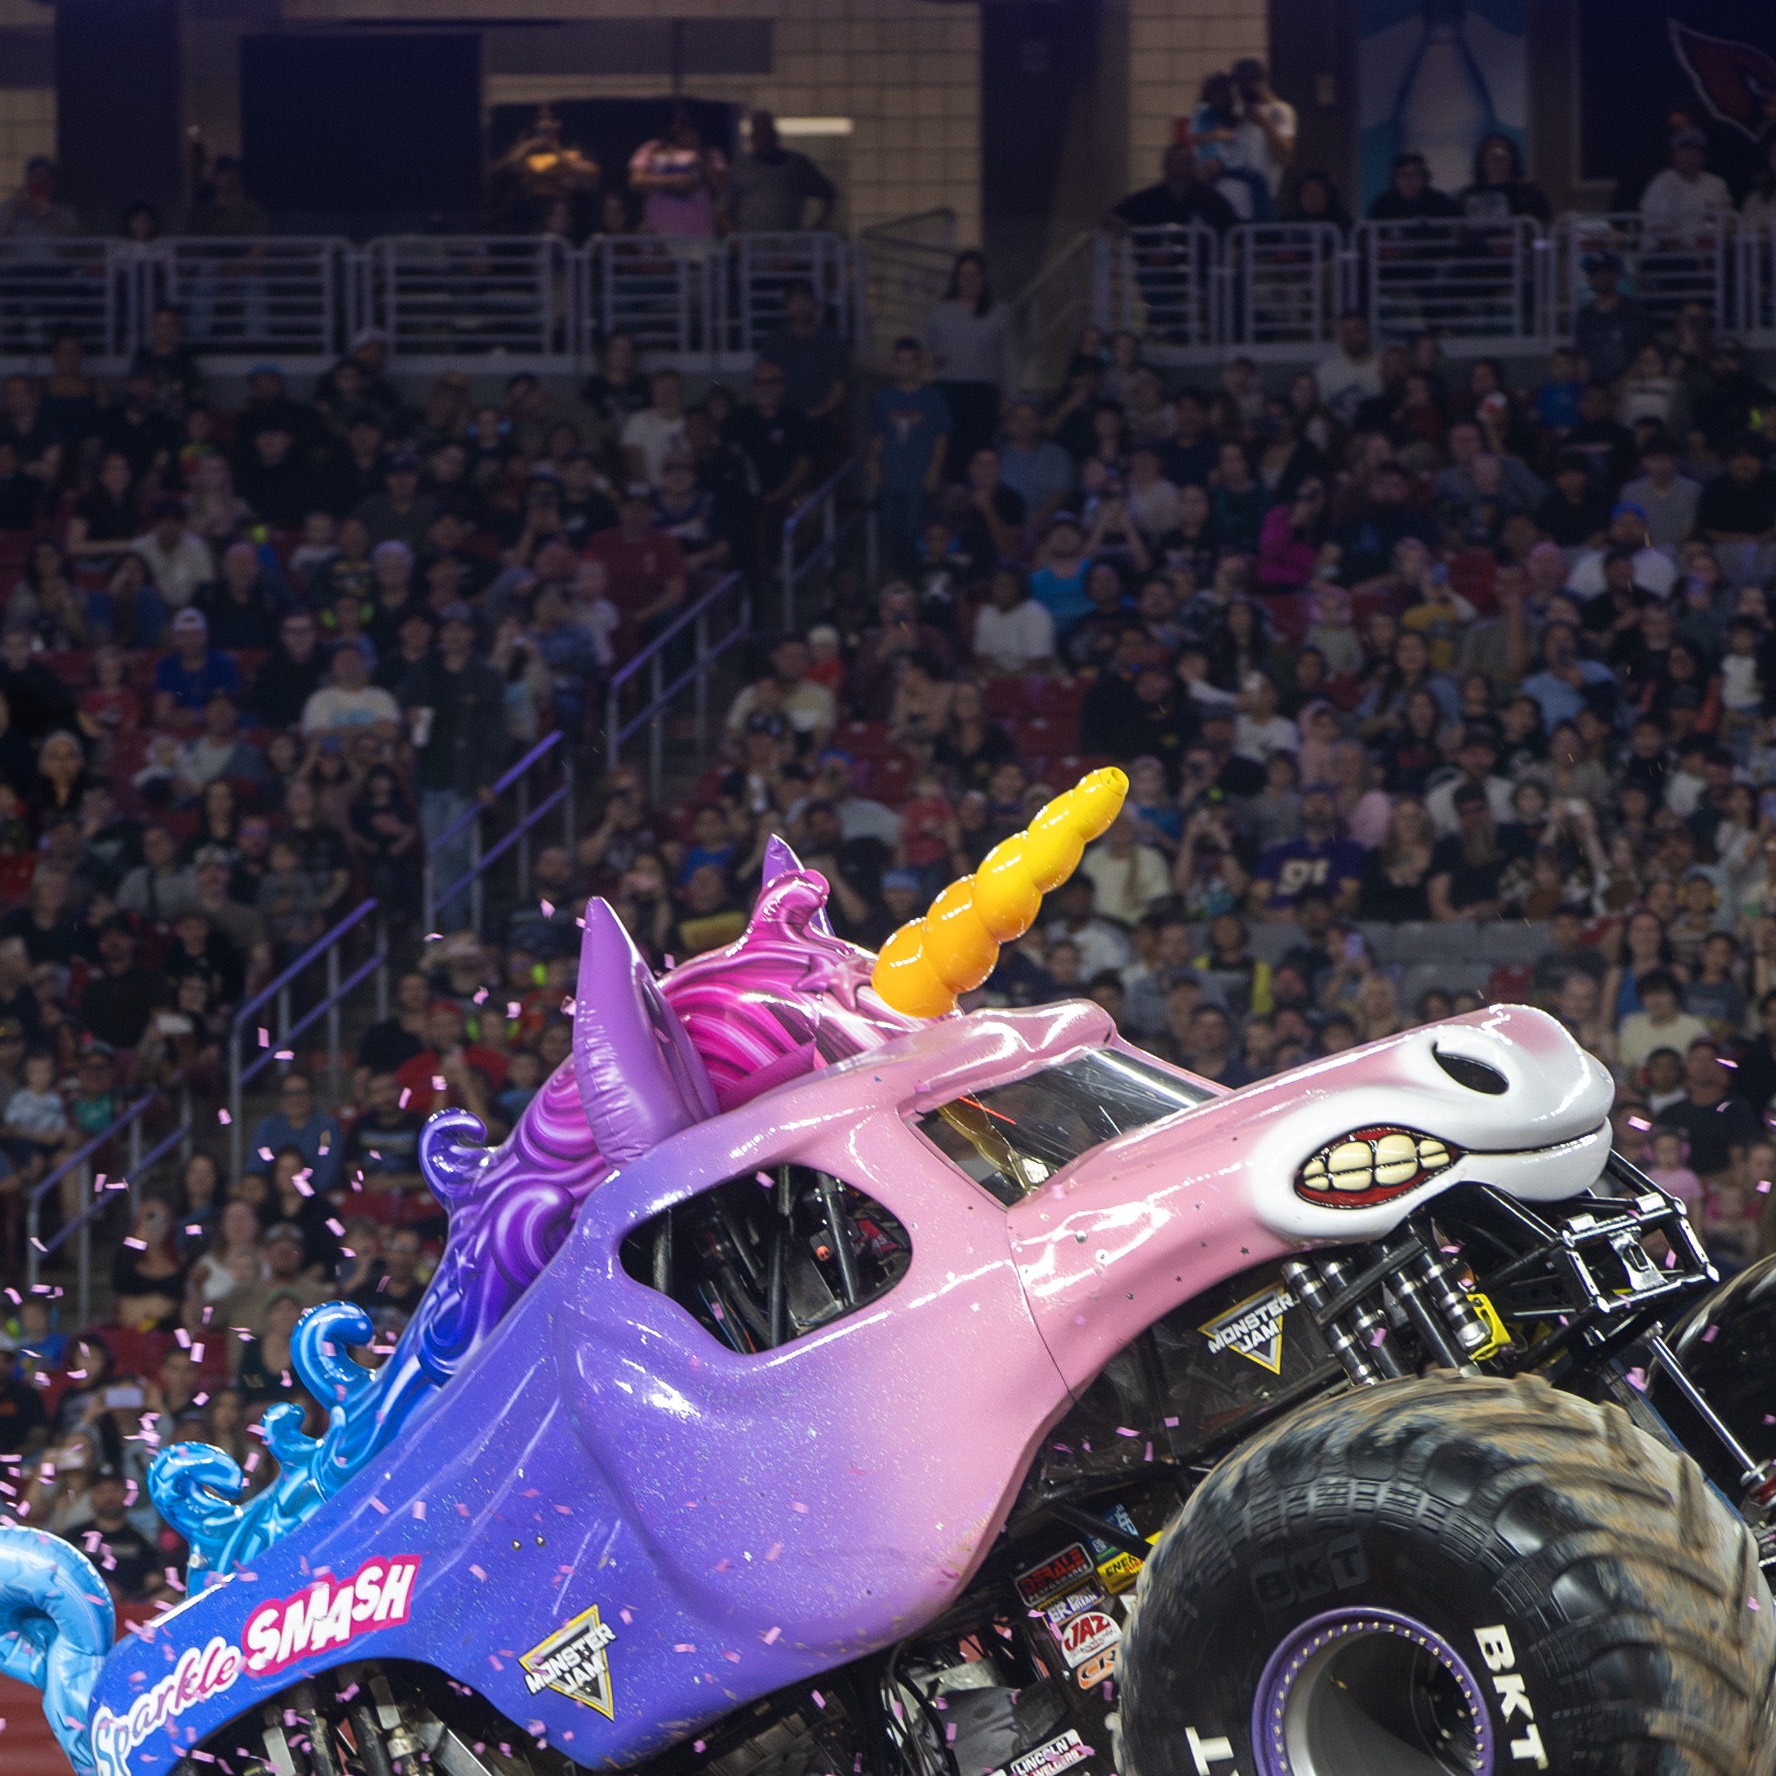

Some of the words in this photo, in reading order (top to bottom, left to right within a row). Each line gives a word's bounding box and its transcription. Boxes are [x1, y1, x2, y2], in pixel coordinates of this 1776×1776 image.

[1207, 1292, 1293, 1353] MONSTER
[1238, 1322, 1280, 1354] JAM
[245, 1562, 418, 1673] SMASH
[1064, 1614, 1110, 1652] JAZ
[524, 1622, 617, 1694] MONSTER
[563, 1654, 606, 1694] JAM
[1472, 1623, 1549, 1771] BKT
